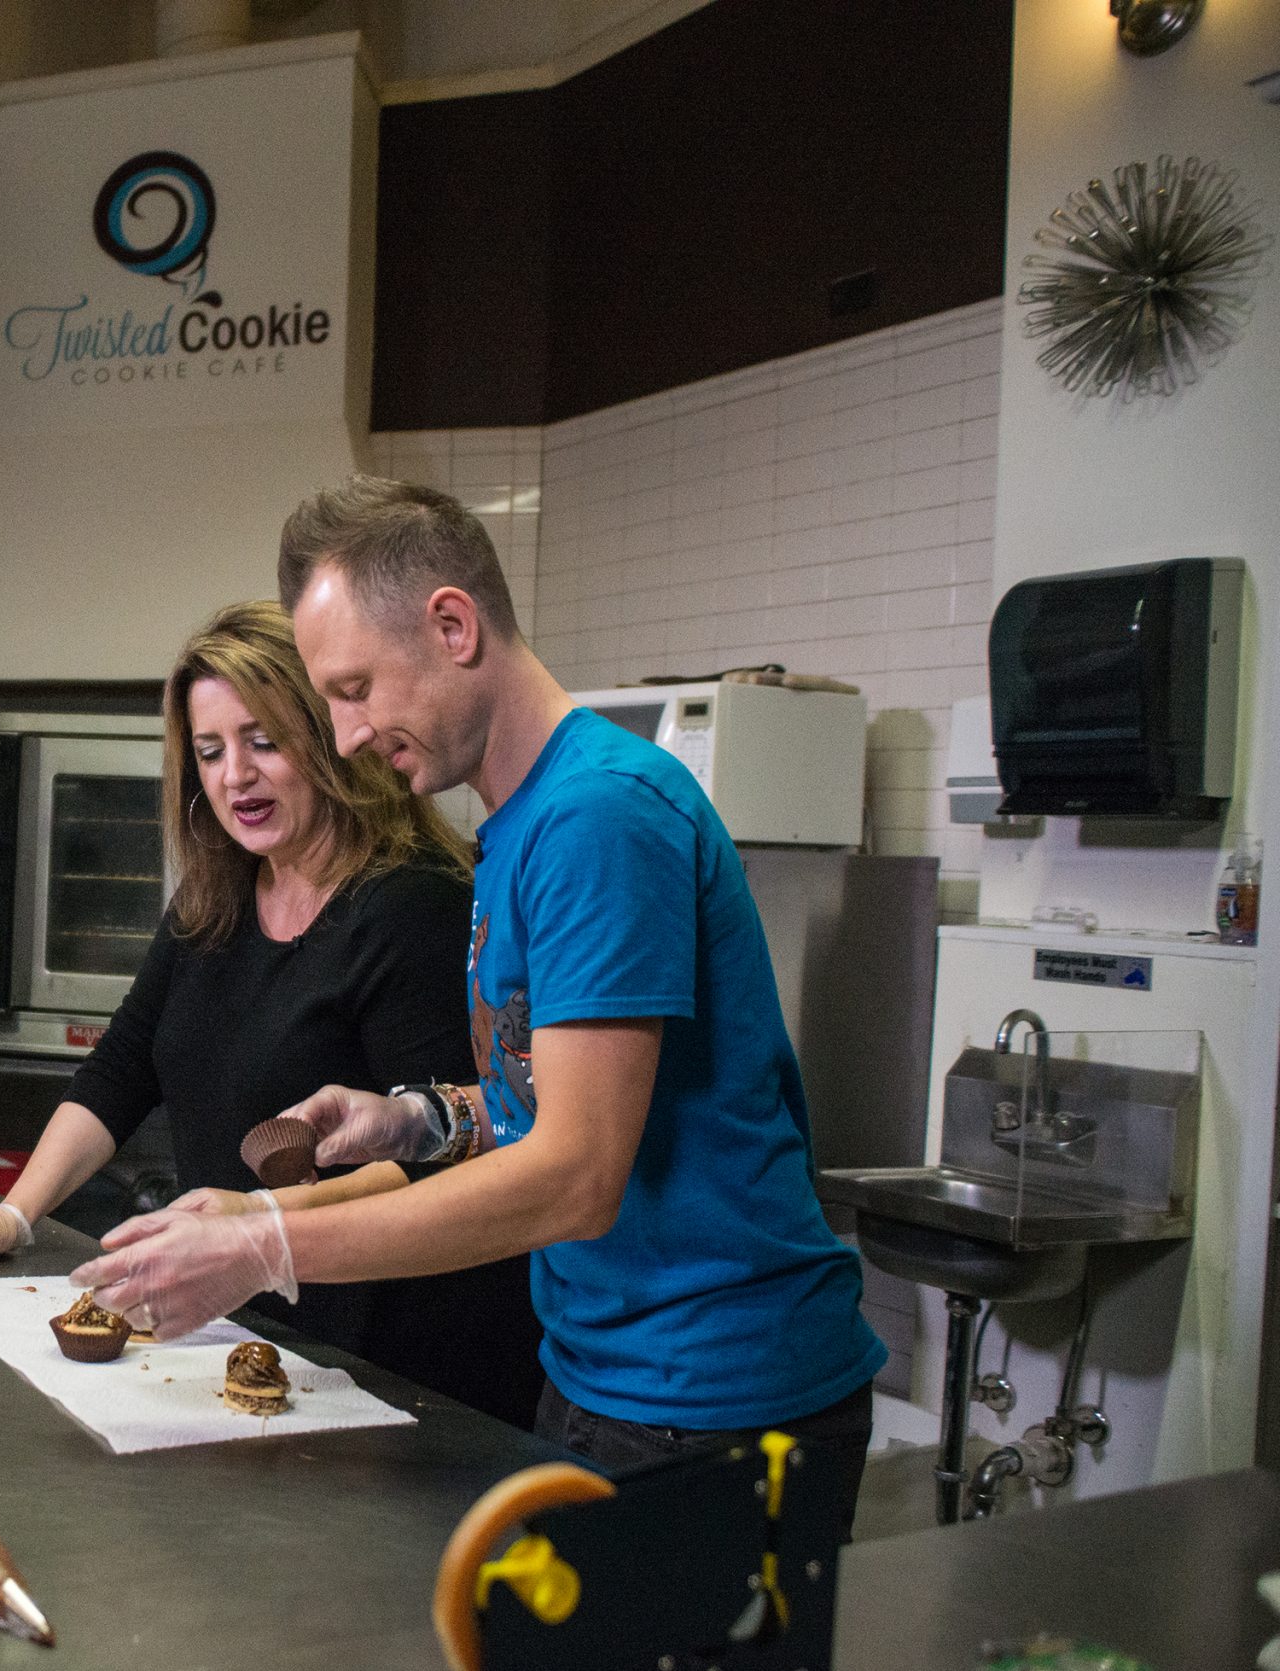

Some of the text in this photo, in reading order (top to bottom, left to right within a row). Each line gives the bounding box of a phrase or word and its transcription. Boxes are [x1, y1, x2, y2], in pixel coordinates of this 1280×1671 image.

[4, 294, 331, 382] Twisted Cookie
[71, 352, 286, 386] COOKIE CAFÉ
